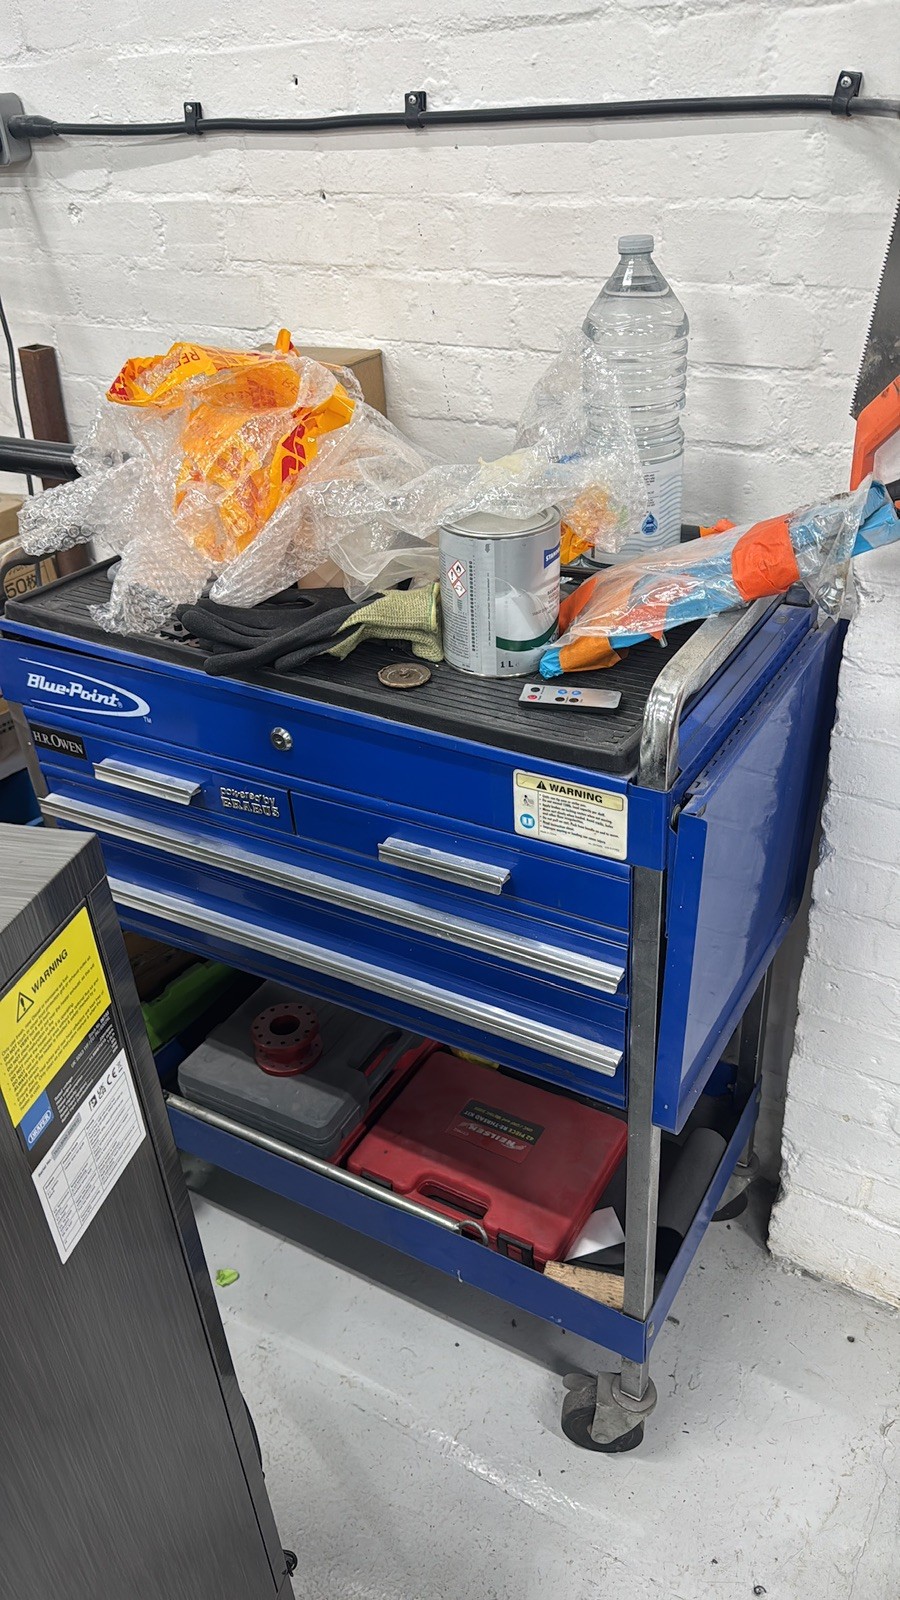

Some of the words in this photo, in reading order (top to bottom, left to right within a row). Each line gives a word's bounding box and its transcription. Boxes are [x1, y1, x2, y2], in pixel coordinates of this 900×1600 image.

[508, 660, 514, 668] L
[549, 783, 603, 804] WARNING
[221, 796, 280, 818] BRABUS
[31, 948, 69, 994] WARNING
[464, 1110, 475, 1118] KIT
[475, 1114, 508, 1131] RE-THREAD
[468, 1122, 517, 1147] NEILSEN
[508, 1128, 524, 1139] PIECE
